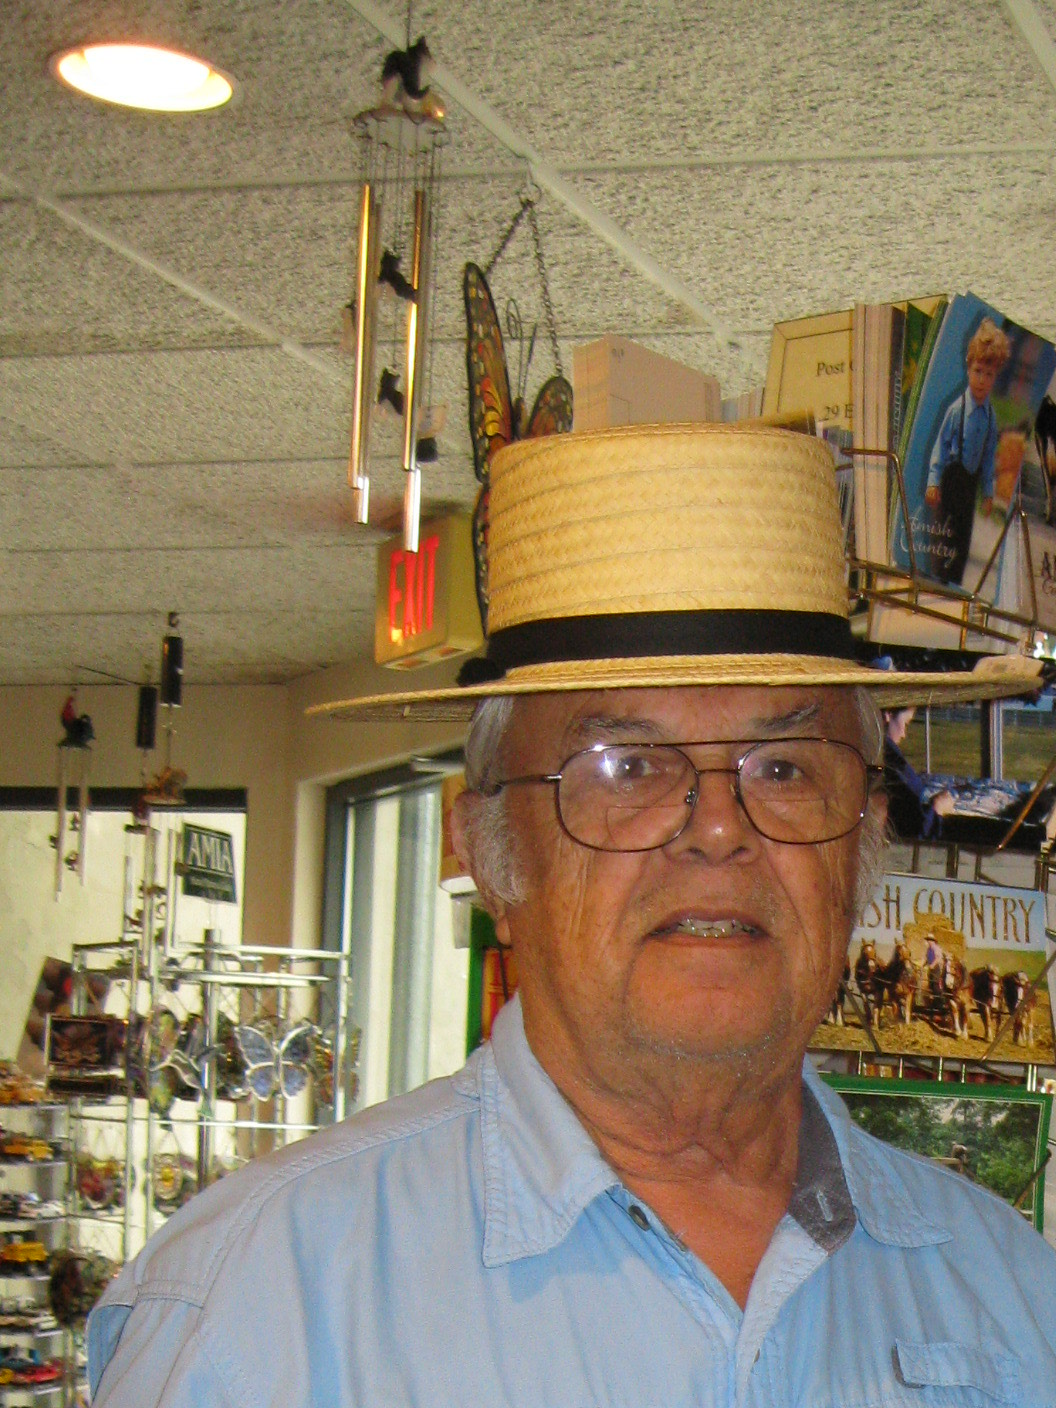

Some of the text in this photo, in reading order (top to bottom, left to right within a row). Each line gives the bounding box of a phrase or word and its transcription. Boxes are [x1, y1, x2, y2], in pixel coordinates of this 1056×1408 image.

[816, 362, 844, 377] Post
[389, 534, 439, 644] EXIT
[913, 888, 1036, 943] COUNTRY
